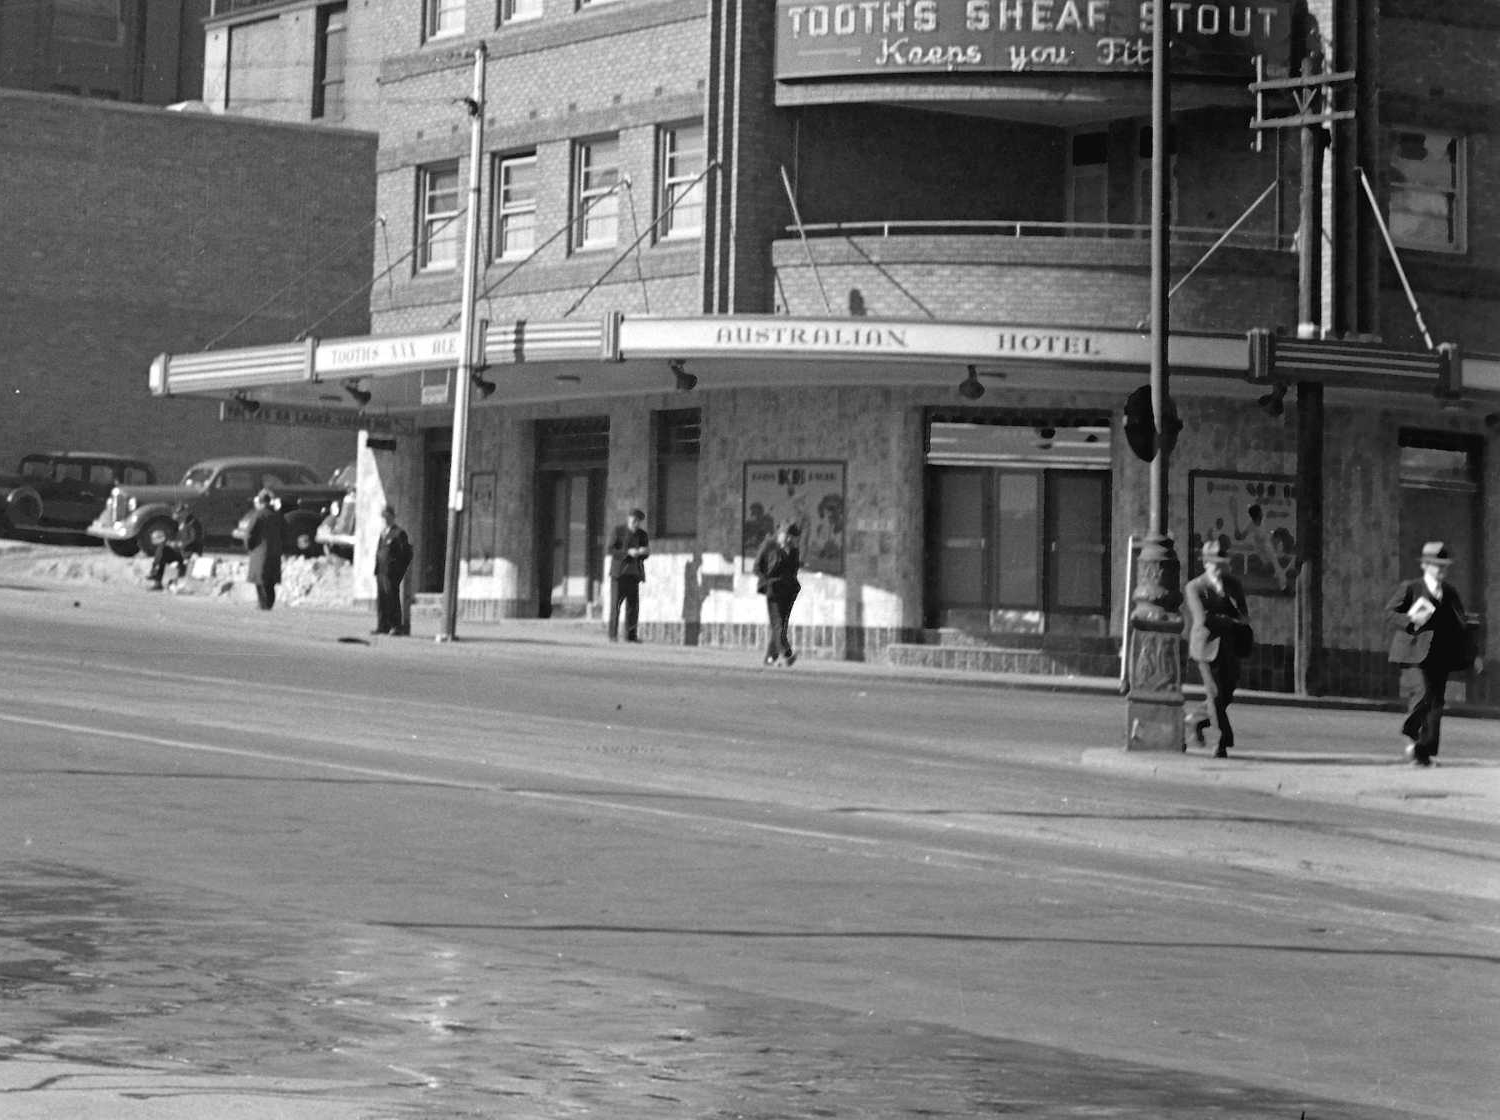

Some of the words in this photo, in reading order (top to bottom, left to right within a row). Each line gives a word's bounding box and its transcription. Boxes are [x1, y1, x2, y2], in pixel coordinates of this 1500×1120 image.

[1140, 0, 1278, 37] STOUT
[876, 38, 982, 71] Keeps
[1009, 45, 1069, 72] you
[716, 326, 909, 349] AUSTRALIAN
[998, 333, 1101, 356] HOTEL
